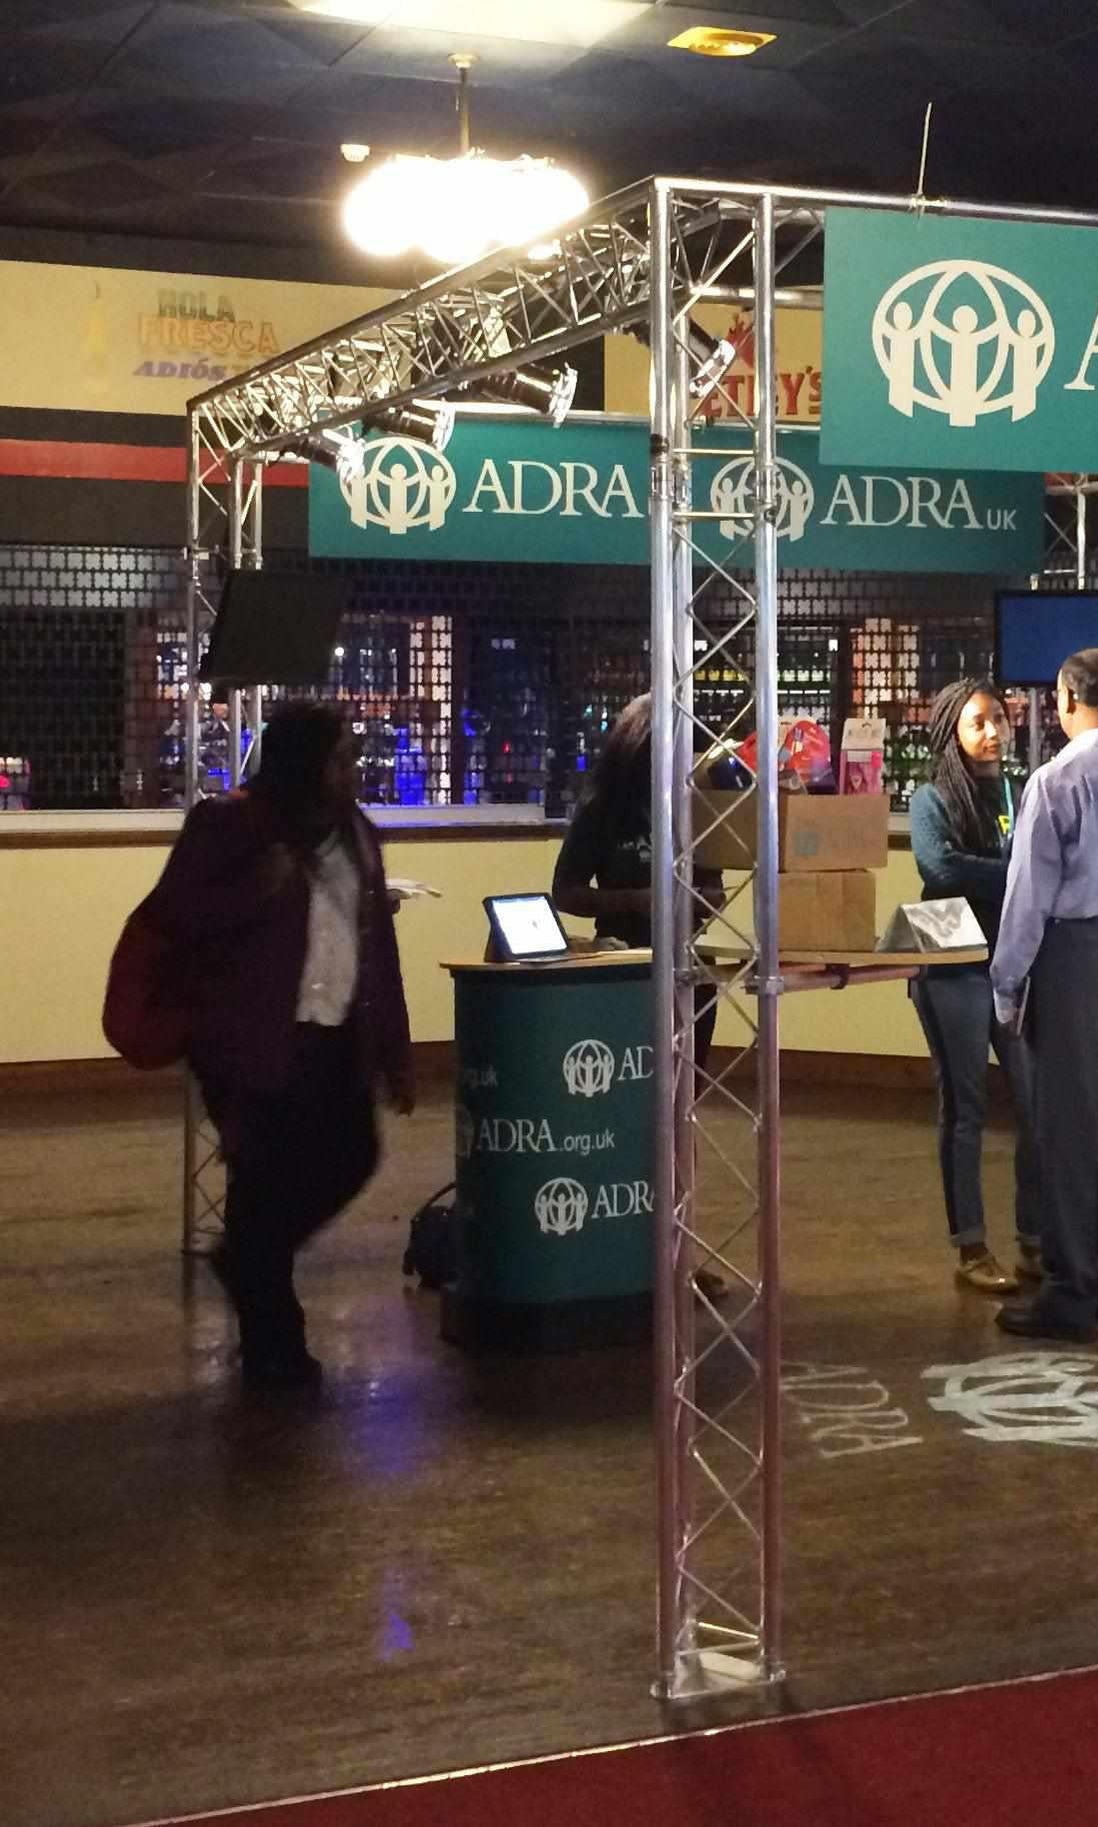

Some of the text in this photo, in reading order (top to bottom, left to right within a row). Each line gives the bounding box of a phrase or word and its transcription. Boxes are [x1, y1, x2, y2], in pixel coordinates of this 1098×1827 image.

[139, 312, 280, 356] FRESCA
[462, 458, 645, 518] ADRA
[820, 474, 1018, 531] ADRA UK
[618, 1046, 655, 1082] AD
[590, 1179, 655, 1219] ADR
